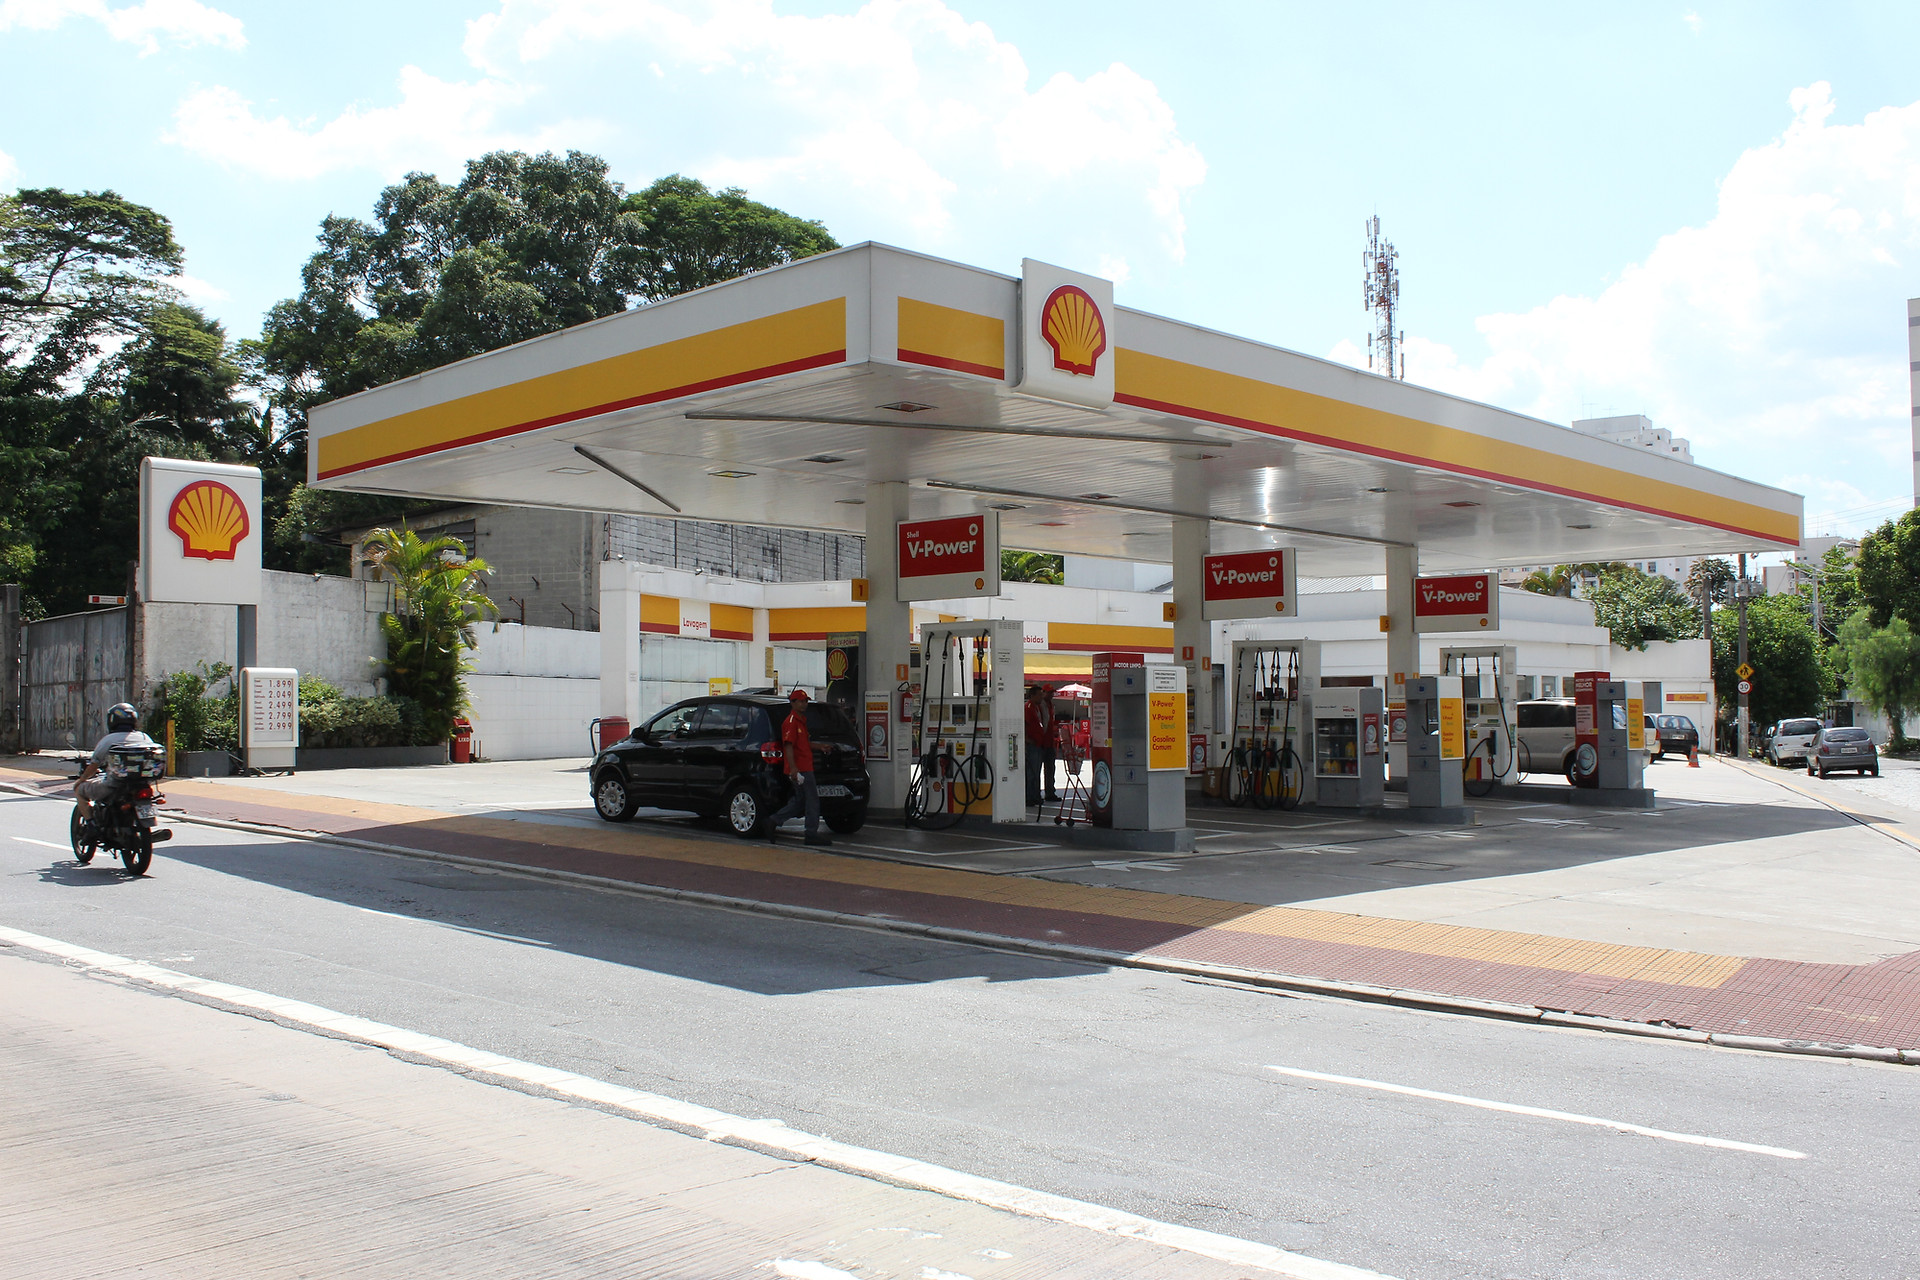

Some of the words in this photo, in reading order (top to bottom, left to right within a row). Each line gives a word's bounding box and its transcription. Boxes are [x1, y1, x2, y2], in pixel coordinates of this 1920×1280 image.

[907, 540, 976, 559] V-Power
[1212, 569, 1276, 584] V-Power
[1423, 590, 1482, 603] V-Power
[683, 617, 708, 630] Lavagem
[269, 680, 292, 688] 1.899
[268, 690, 292, 698] 2.049
[268, 701, 292, 709] 2.499
[1151, 699, 1174, 708] V-Power
[268, 712, 292, 720] 2.799
[1152, 713, 1174, 721] V-Power
[268, 722, 292, 730] 2.999
[1152, 735, 1176, 743] Gasolina
[1152, 743, 1173, 751] Comum
